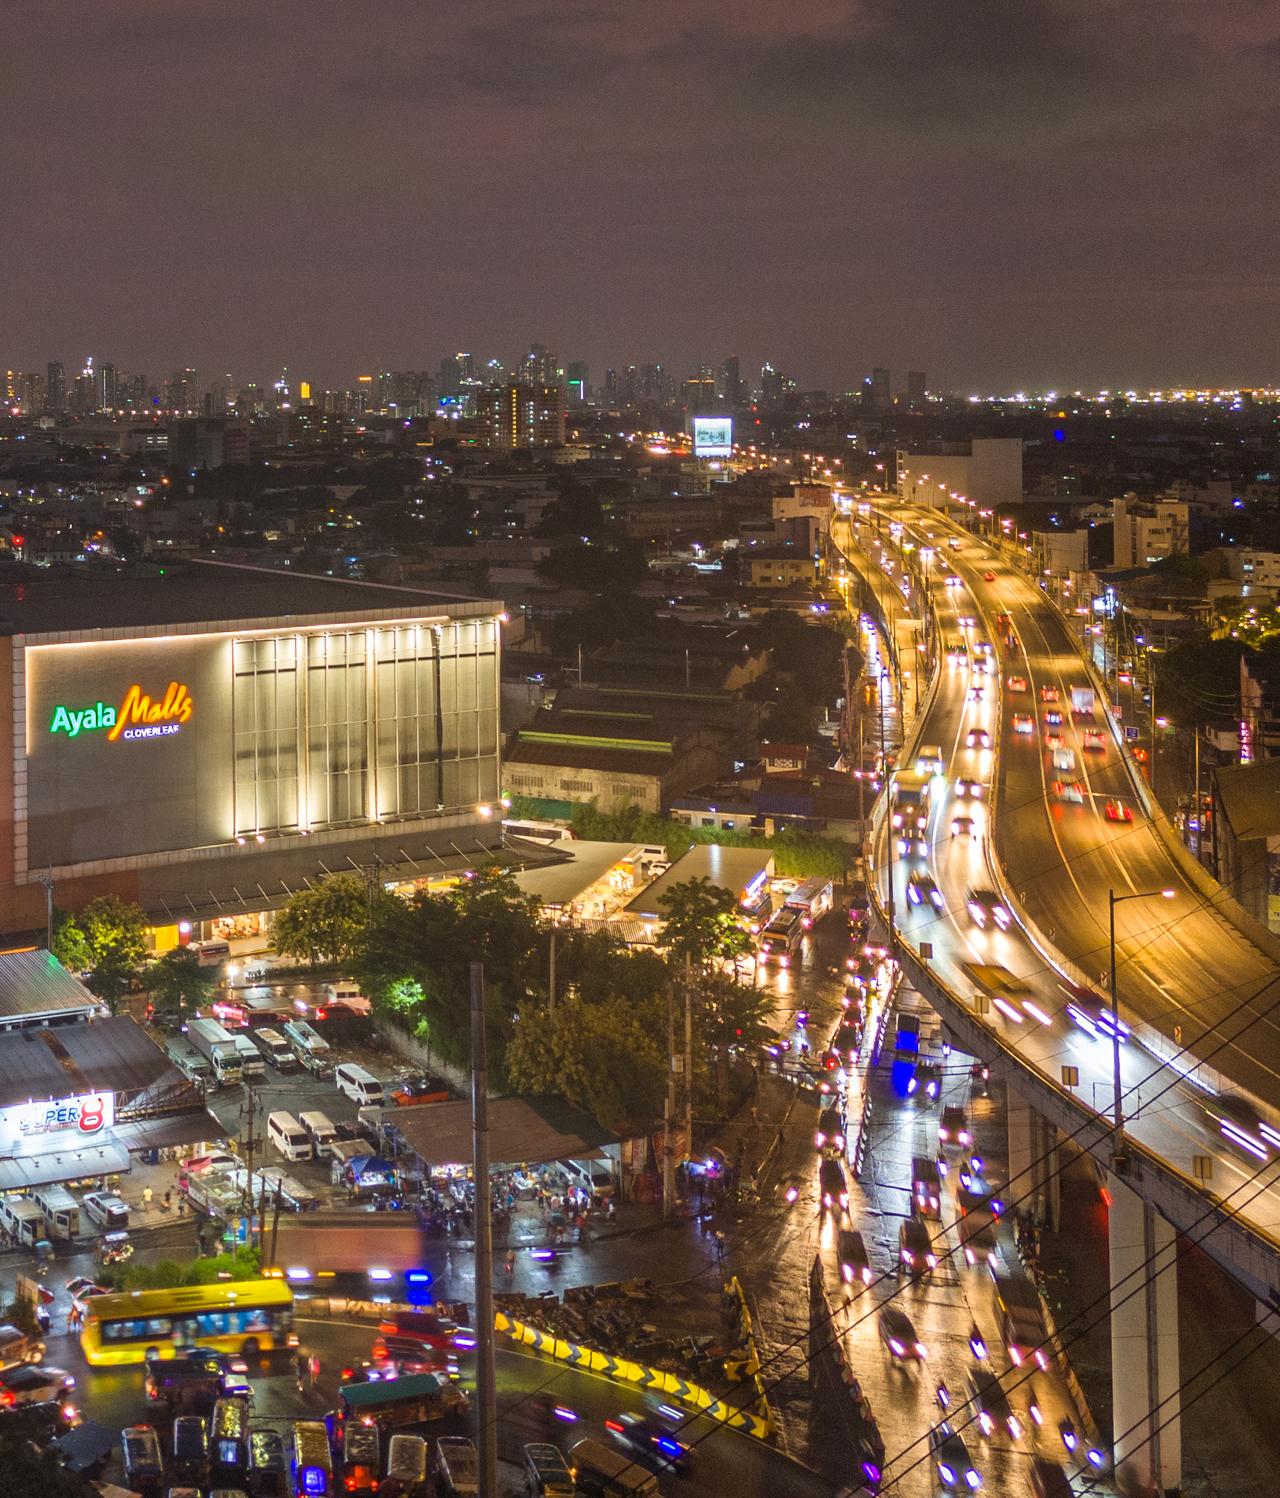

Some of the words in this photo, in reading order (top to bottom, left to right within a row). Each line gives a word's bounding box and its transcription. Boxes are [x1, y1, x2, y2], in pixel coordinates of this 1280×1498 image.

[50, 702, 116, 737] Ayala
[108, 681, 193, 741] Malls
[123, 724, 180, 739] CLOVERLEAF
